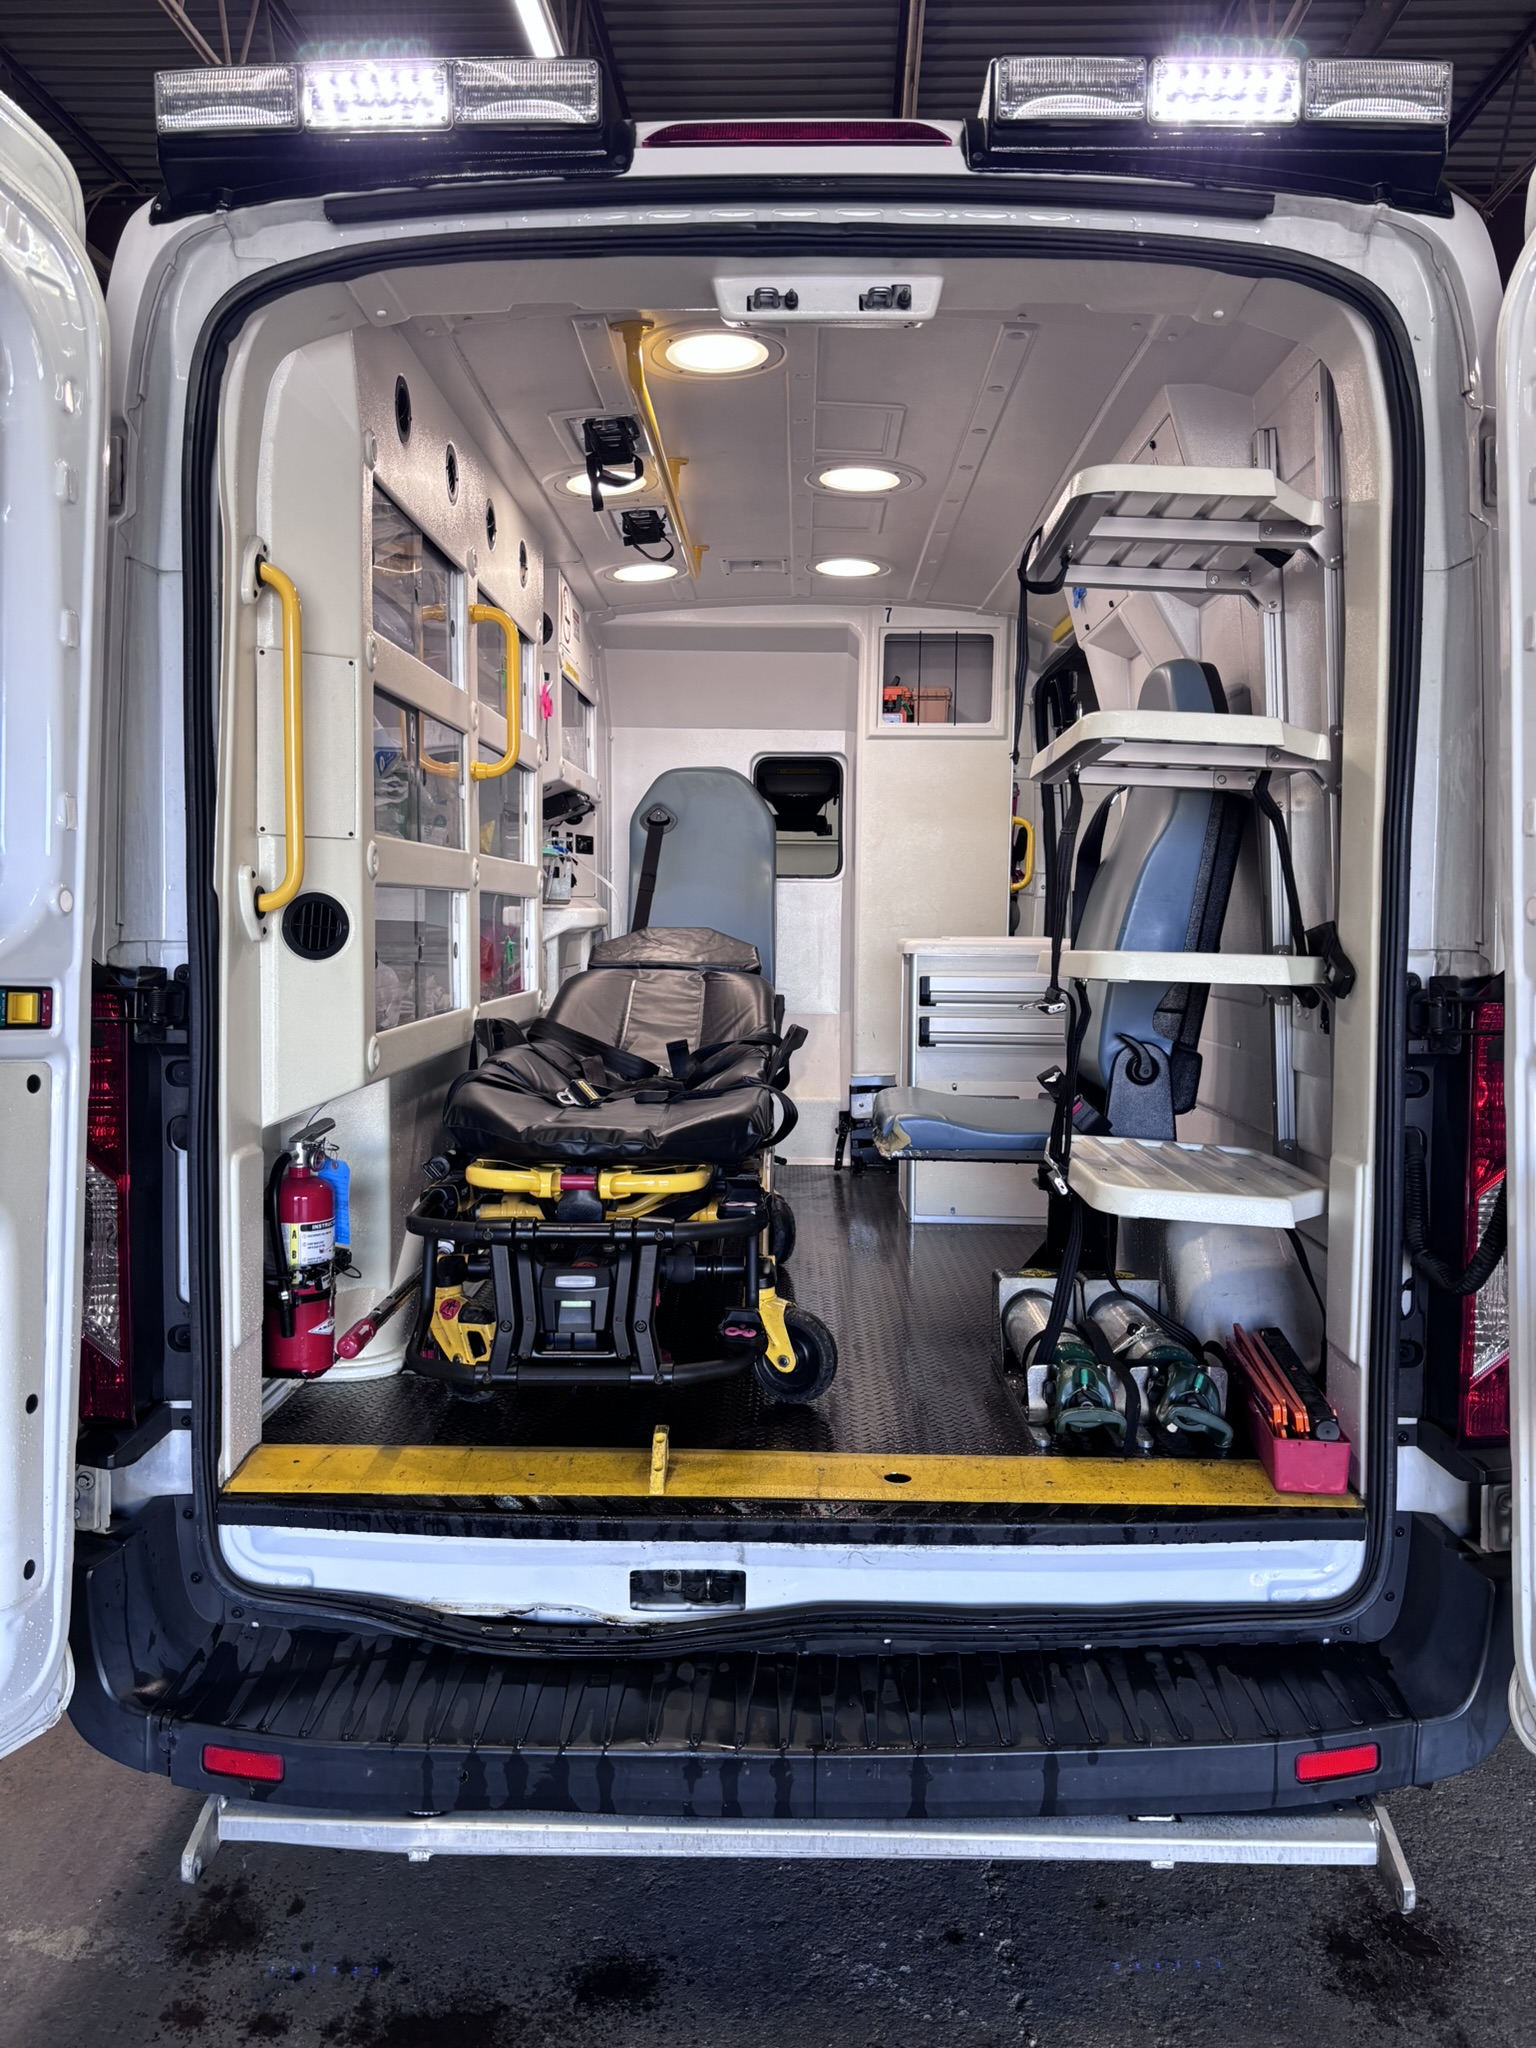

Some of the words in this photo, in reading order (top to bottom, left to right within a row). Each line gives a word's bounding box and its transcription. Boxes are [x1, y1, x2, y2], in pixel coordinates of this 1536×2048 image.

[885, 607, 892, 623] 7
[292, 1230, 297, 1239] A
[292, 1250, 297, 1259] B
